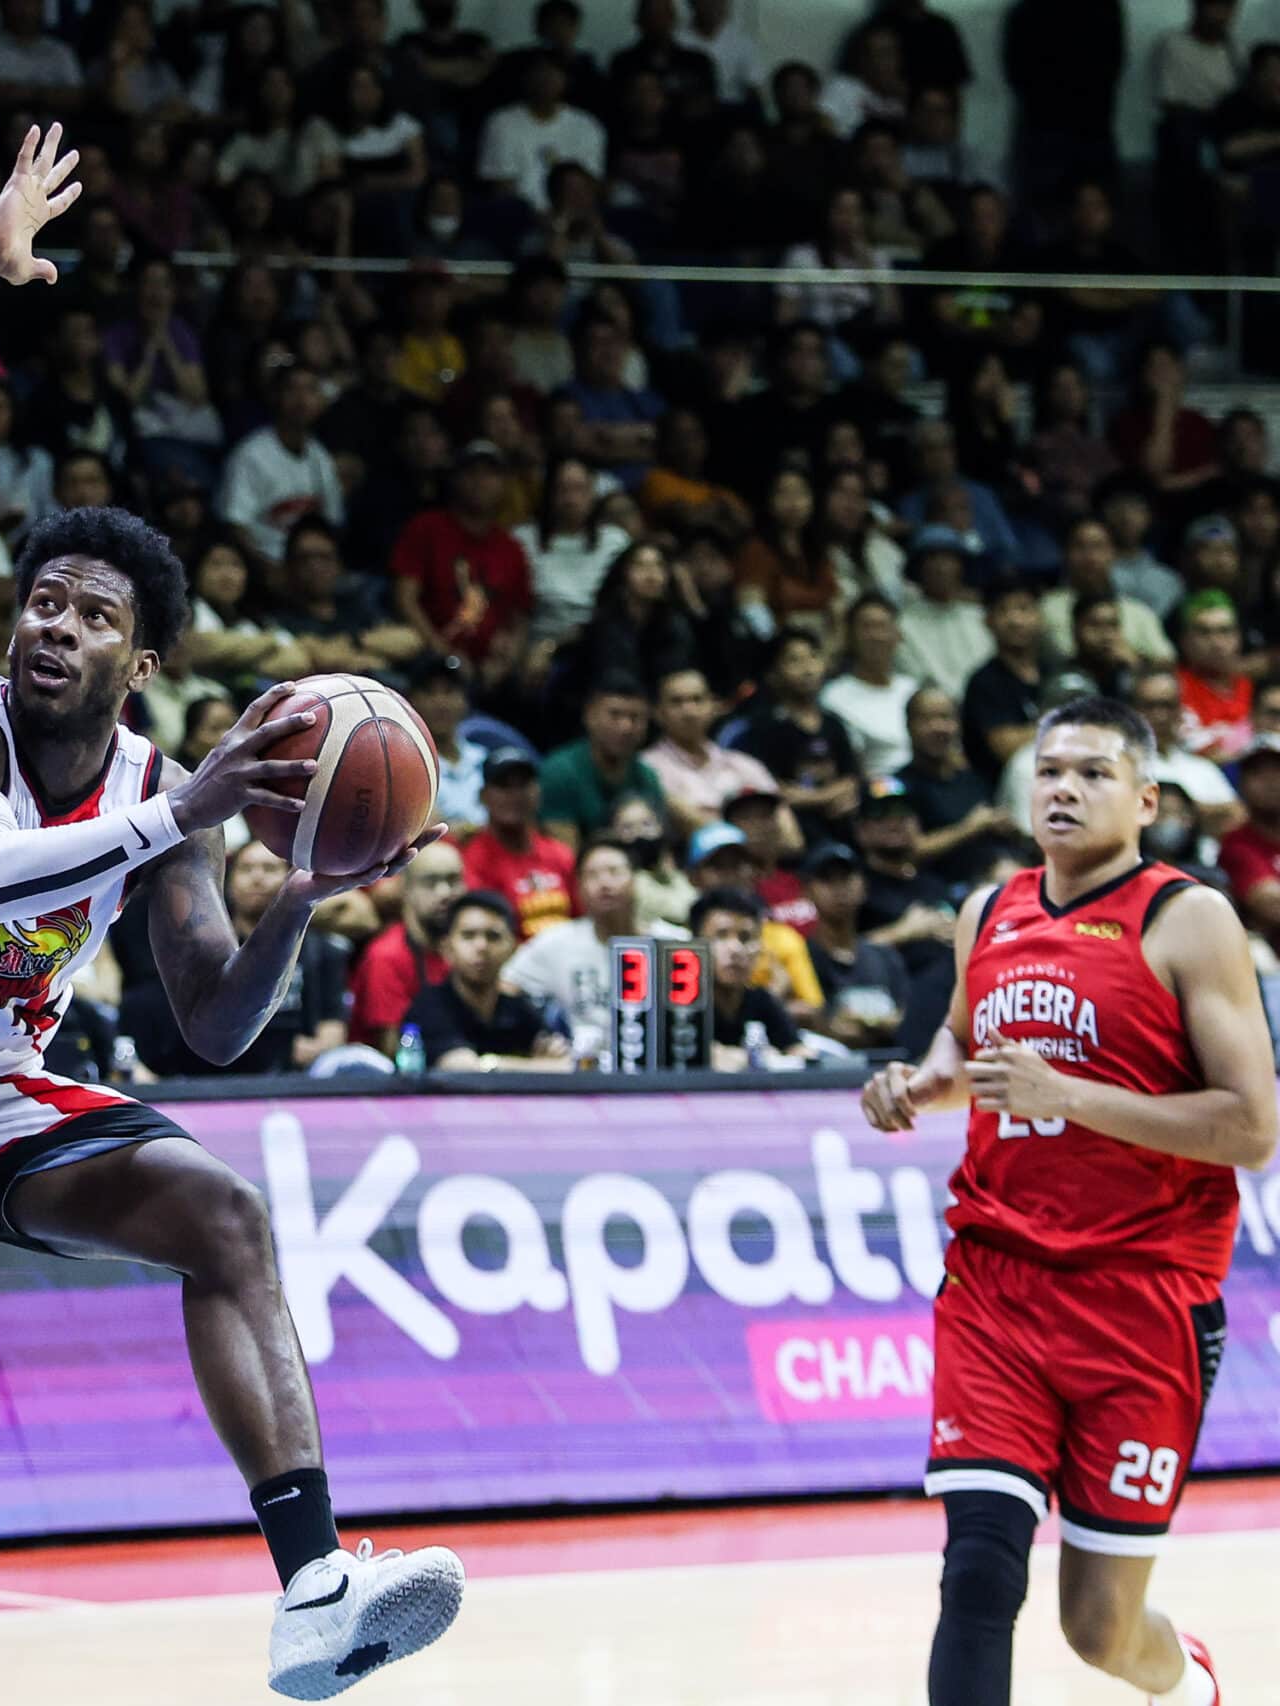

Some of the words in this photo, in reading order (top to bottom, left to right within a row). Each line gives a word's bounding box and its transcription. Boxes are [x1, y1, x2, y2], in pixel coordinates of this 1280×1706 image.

[622, 949, 648, 1004] 3
[668, 948, 701, 1006] 3
[973, 979, 1099, 1047] GINEBRA
[260, 1112, 946, 1375] Kapati
[1110, 1440, 1179, 1505] 29
